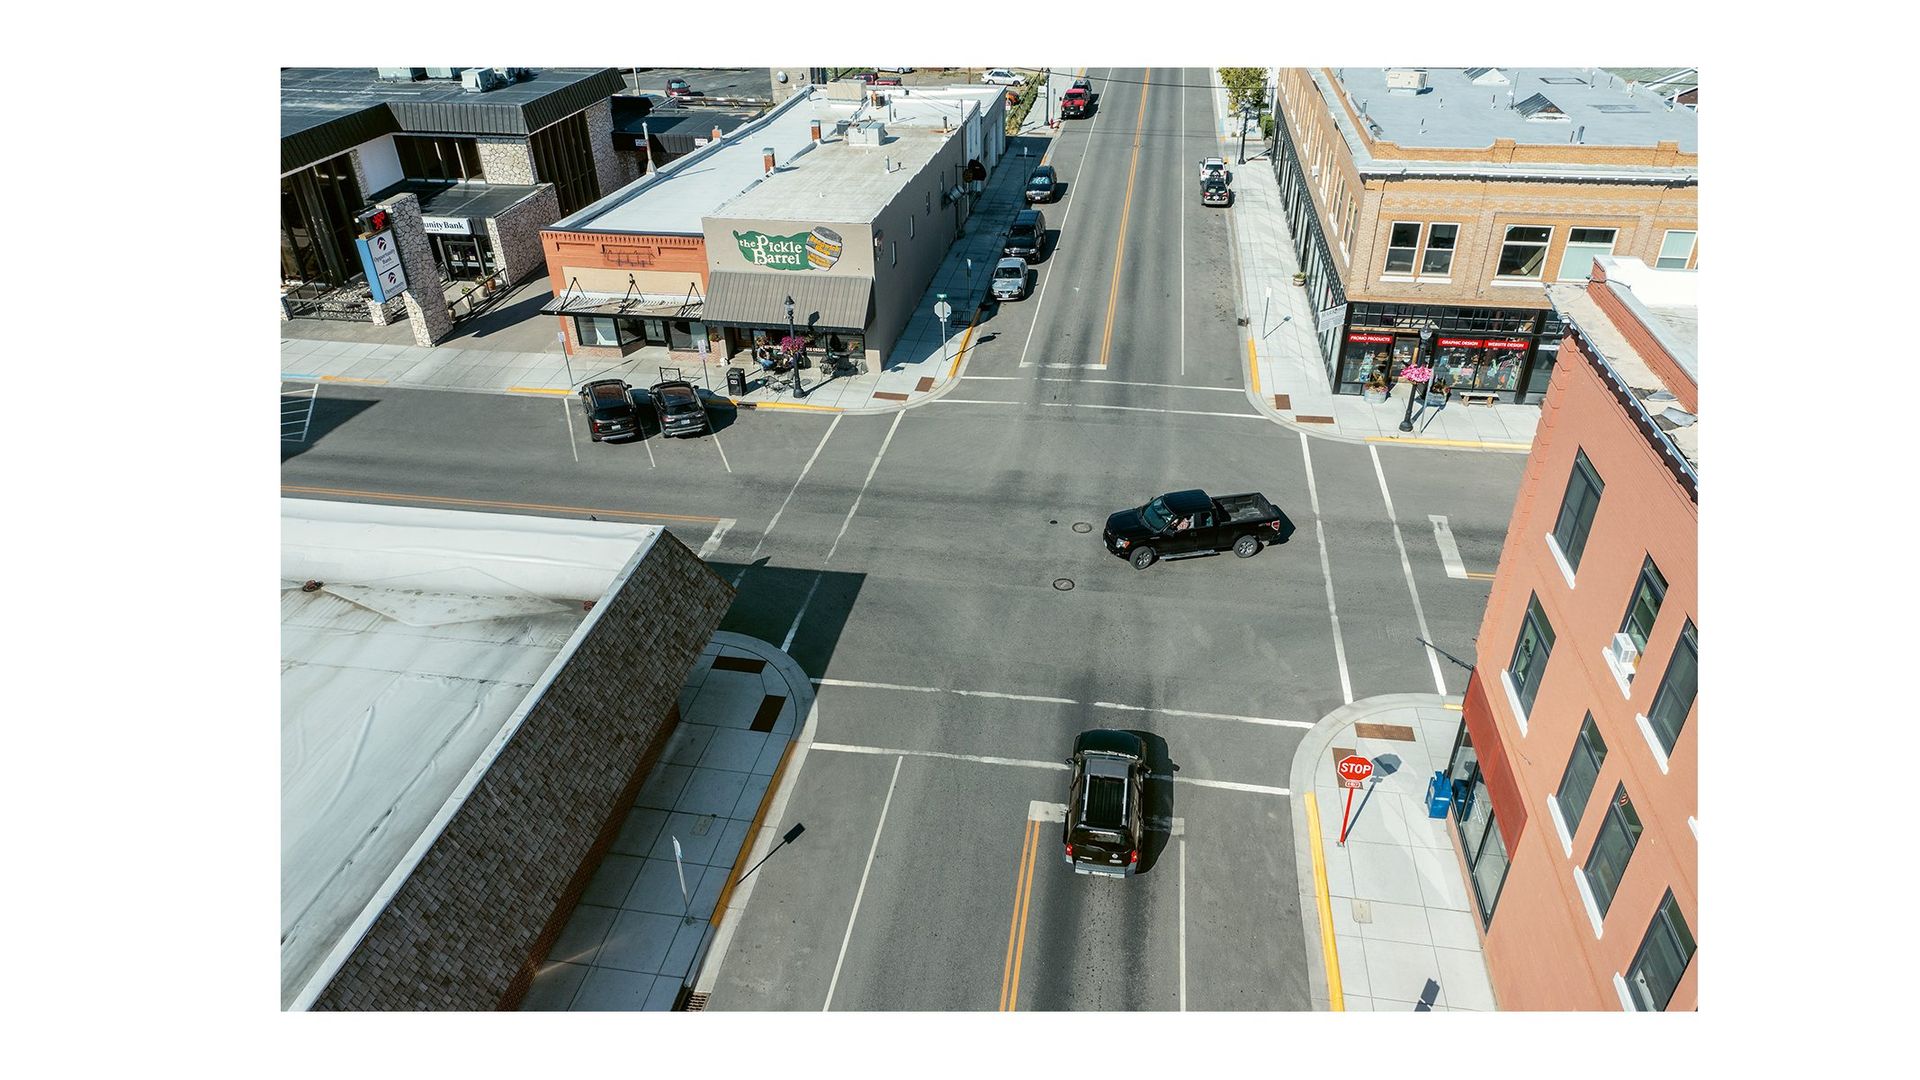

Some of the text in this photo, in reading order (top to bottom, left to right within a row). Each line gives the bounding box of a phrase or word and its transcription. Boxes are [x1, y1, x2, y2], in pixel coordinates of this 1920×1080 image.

[739, 239, 756, 248] the
[755, 235, 802, 254] Pickle
[751, 248, 801, 265] Barrel
[1340, 762, 1371, 774] STOP
